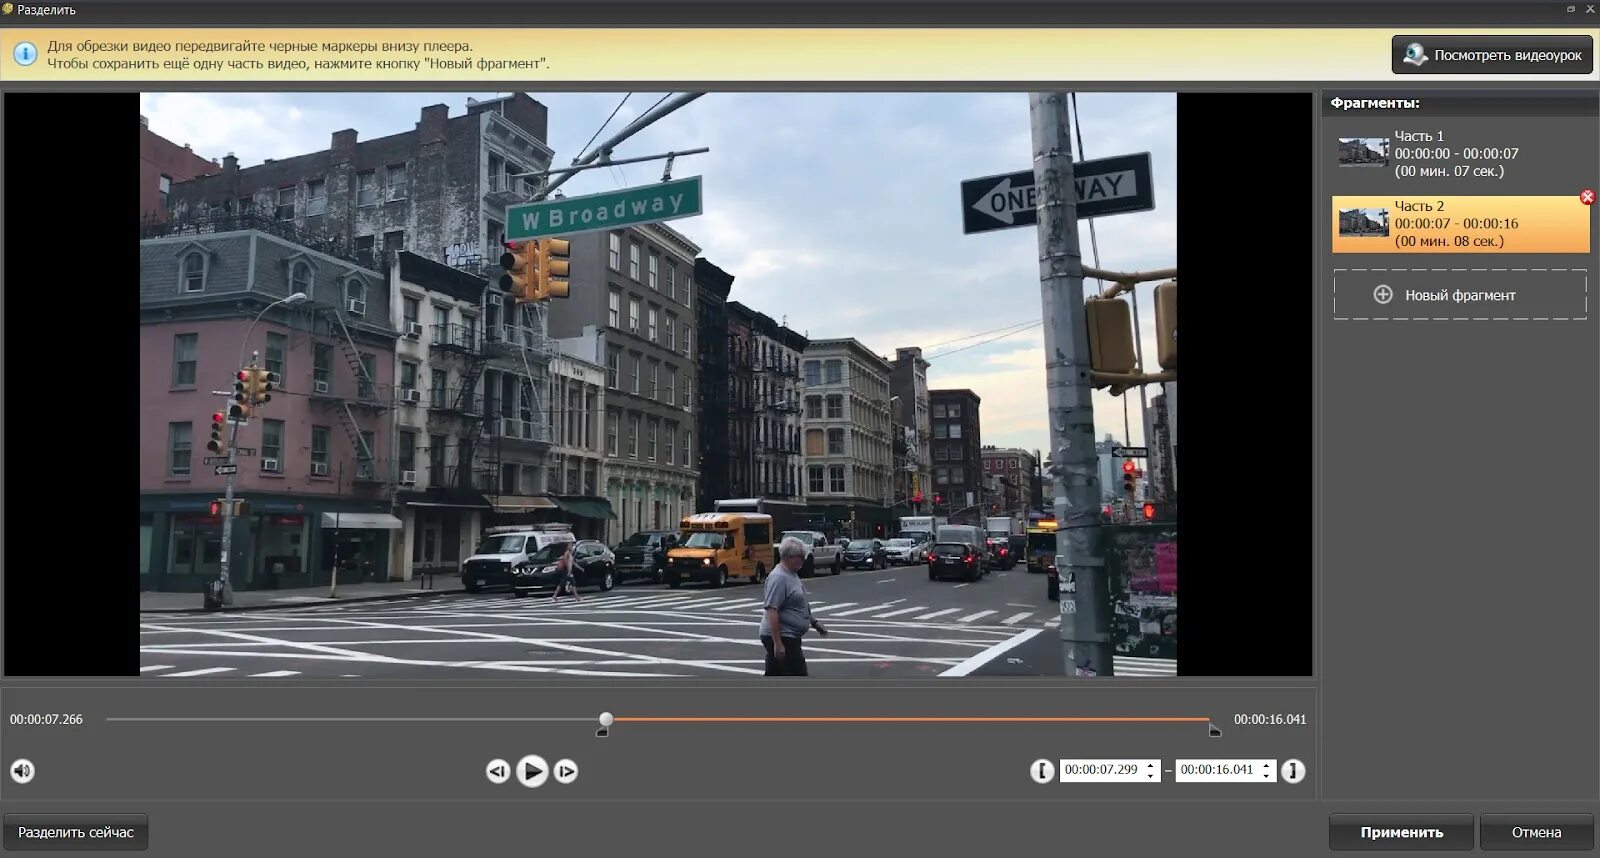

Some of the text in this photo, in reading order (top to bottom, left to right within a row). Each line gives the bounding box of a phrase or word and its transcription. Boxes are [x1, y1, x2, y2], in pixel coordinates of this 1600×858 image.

[16, 4, 77, 17] Разделить
[47, 39, 473, 55] Для обрезки видео передвигайте черные маркеры внизу плеера.
[1434, 48, 1583, 64] Посмотреть видеоурок
[47, 56, 550, 72] Чтобы сохранить ещё одну часть видео, нажмите кнопку "Новый фрагмент".
[1330, 96, 1421, 110] Фрагменты:
[1395, 130, 1444, 143] Часть 1
[1395, 147, 1451, 160] 00:00:00
[1463, 147, 1519, 160] 00:00:07
[1395, 164, 1505, 179] (00 мин. 07 сек.)
[991, 187, 1036, 213] ONE
[1395, 200, 1445, 212] Часть 2
[522, 193, 683, 231] W Broadway
[1395, 217, 1451, 230] 00:00:07
[1463, 217, 1519, 230] 00:00:16
[1395, 234, 1505, 249] (00 мин. 08 сек.)
[1405, 287, 1517, 304] Новый фрагмент
[10, 713, 84, 725] 00:00:07.266
[1234, 713, 1307, 725] 00:00:16.041
[1065, 763, 1138, 775] 00:00:07.299
[1181, 763, 1254, 775] 00:00:16.041
[18, 825, 135, 840] Разделить сейчас
[1360, 826, 1445, 840] Применить
[1512, 826, 1562, 839] Отмена
